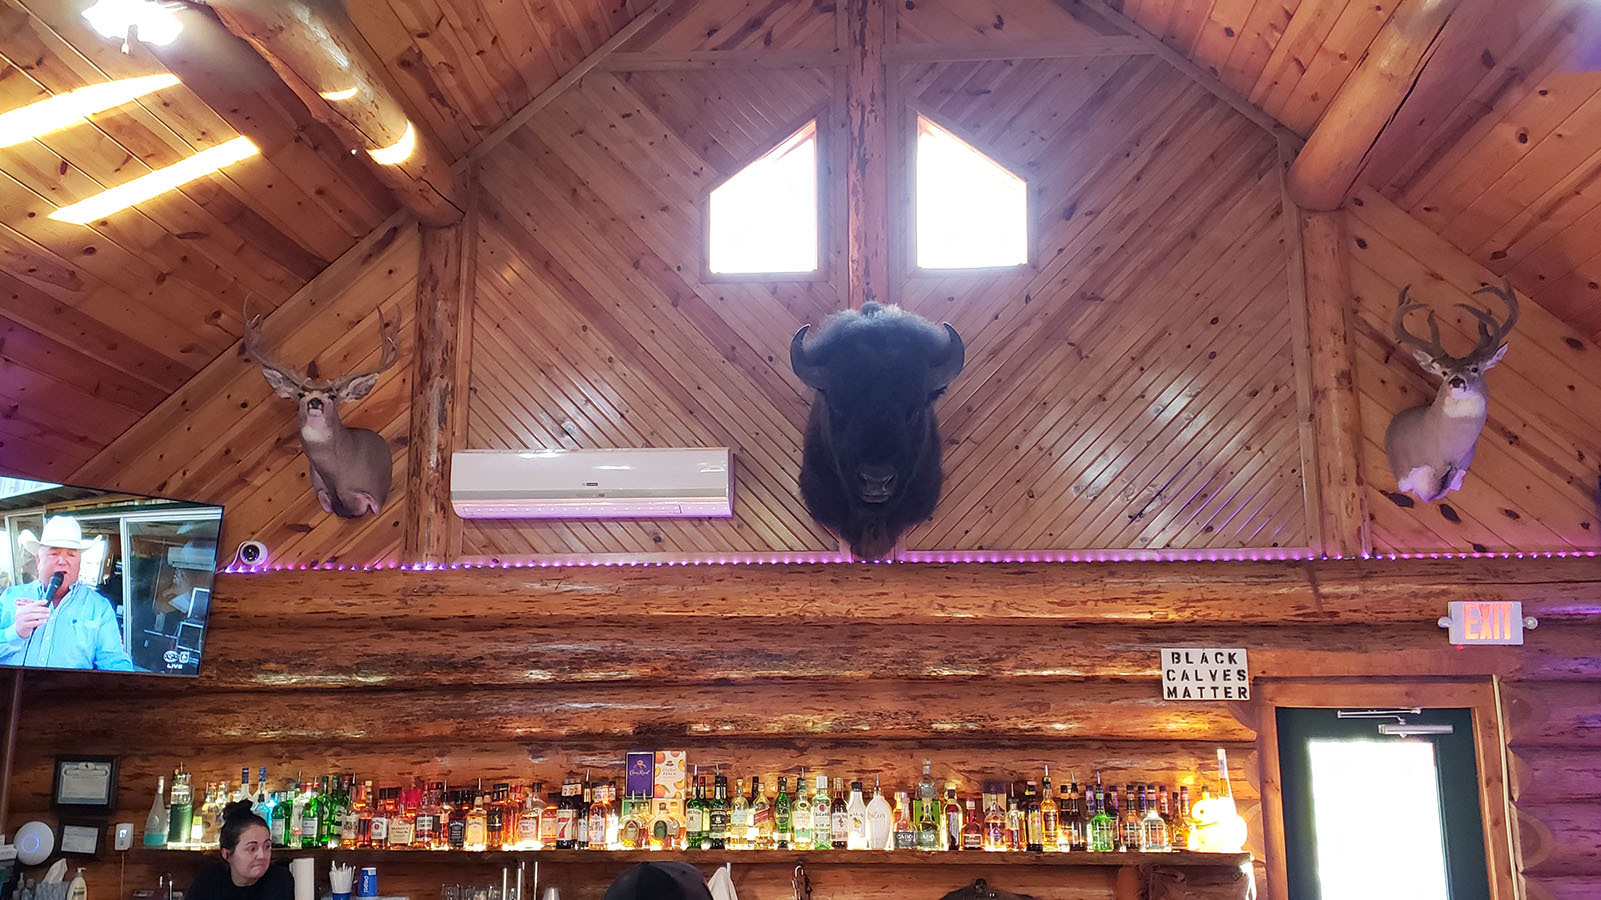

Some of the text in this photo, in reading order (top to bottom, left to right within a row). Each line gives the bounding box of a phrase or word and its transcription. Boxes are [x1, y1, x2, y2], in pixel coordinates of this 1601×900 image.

[1463, 602, 1513, 640] EXIT
[1171, 651, 1238, 665] BLACK
[1166, 669, 1247, 682] CALVES
[1166, 686, 1248, 699] MATTER
[557, 817, 570, 838] 7
